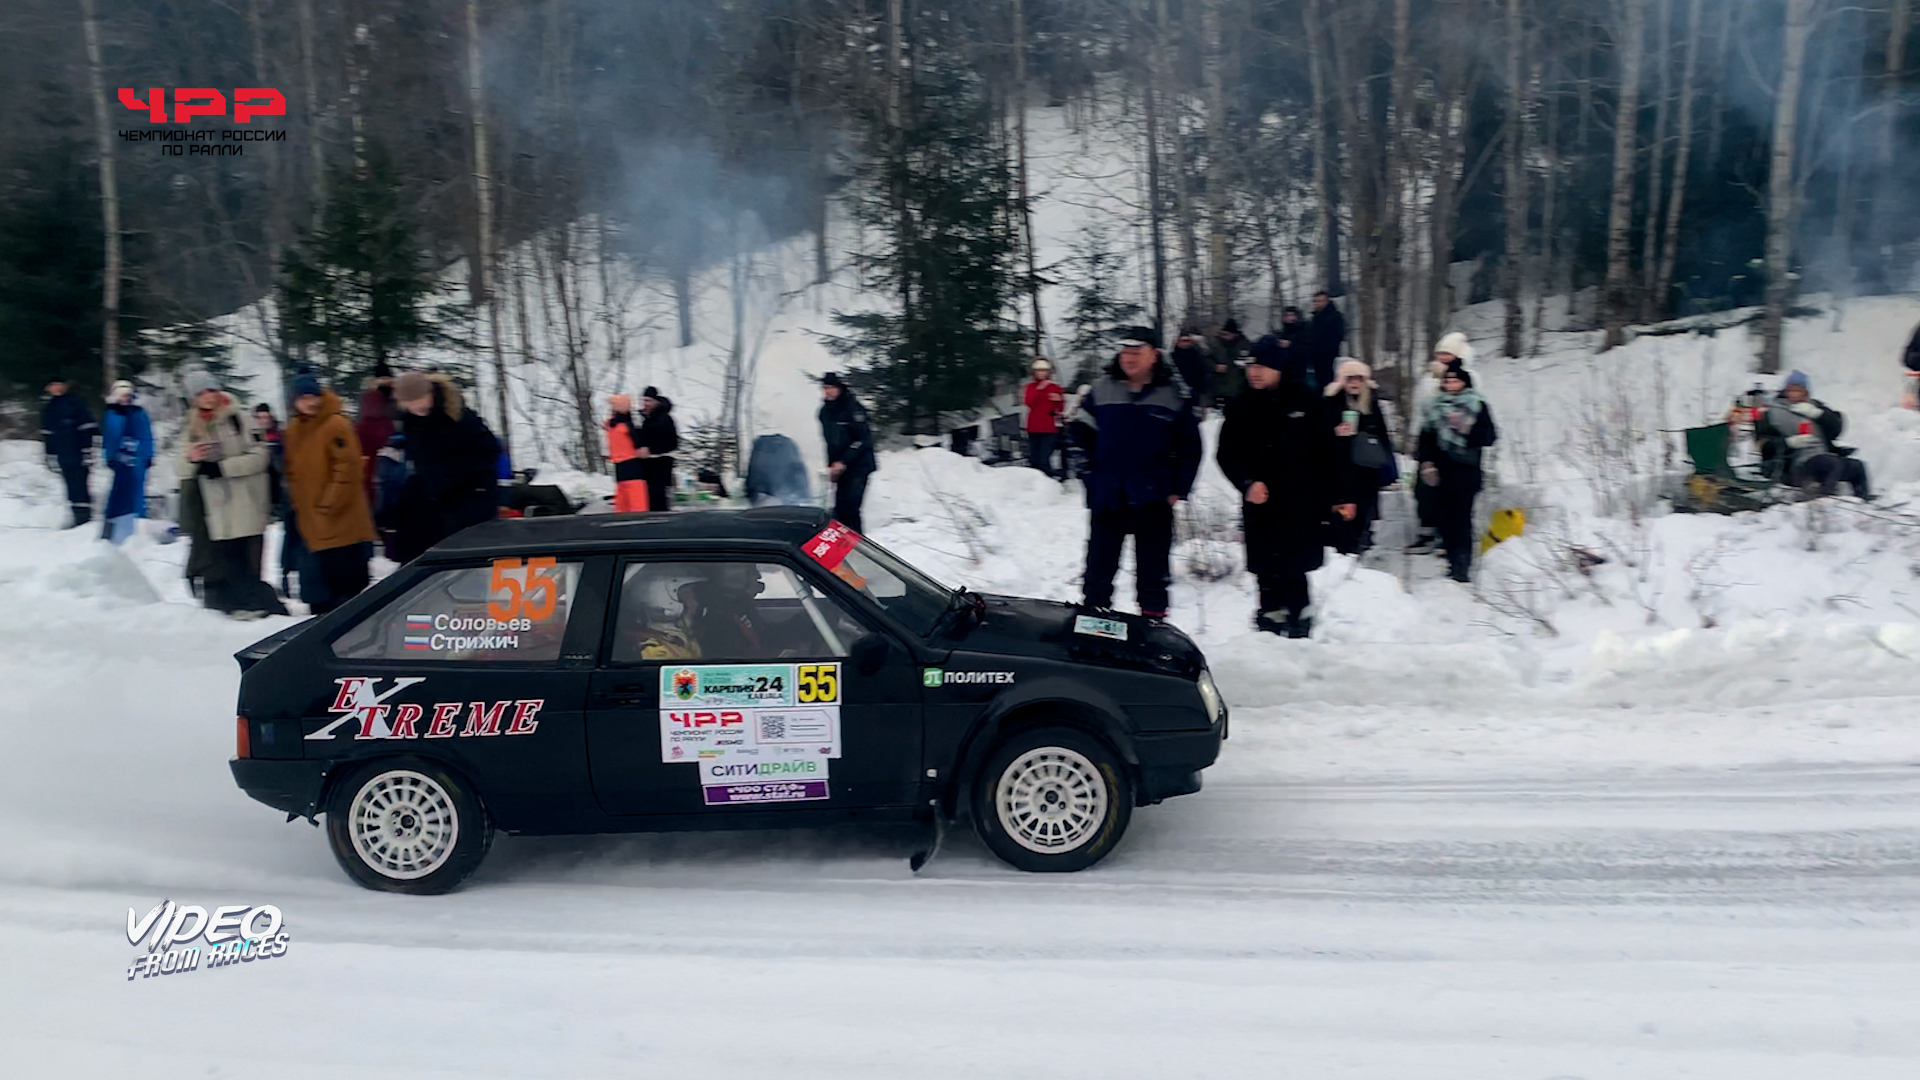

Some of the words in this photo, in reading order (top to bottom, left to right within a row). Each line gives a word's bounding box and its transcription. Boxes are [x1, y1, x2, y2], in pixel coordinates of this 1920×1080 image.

[487, 556, 557, 622] 55
[434, 614, 532, 632] Соловьев
[430, 634, 519, 653] Стрижич
[799, 665, 838, 703] 55
[944, 671, 1016, 684] ПОЛИТЕХ
[304, 676, 545, 740] EXTREME
[669, 711, 744, 728] ЧРР
